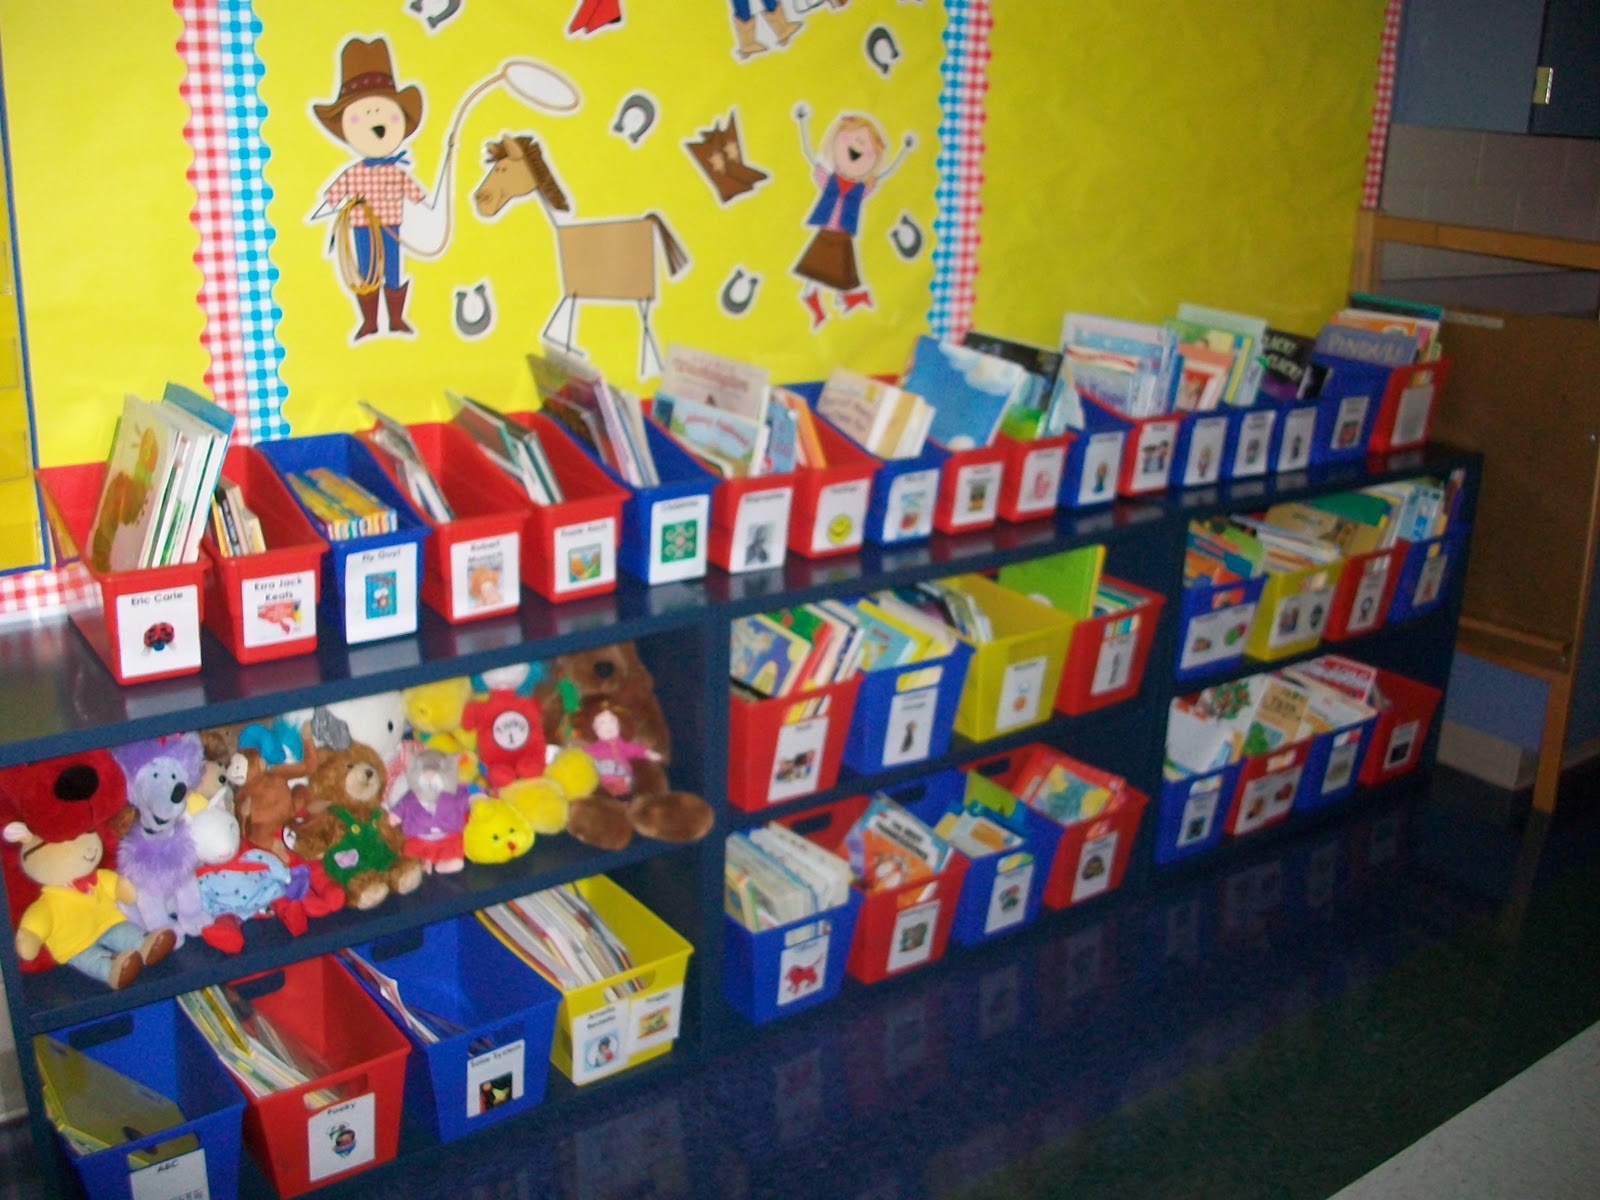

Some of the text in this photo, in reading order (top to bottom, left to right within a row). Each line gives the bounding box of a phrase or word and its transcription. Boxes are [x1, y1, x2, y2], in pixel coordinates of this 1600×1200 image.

[254, 576, 303, 591] Ezra Jack
[131, 591, 184, 606] Eric Carle
[265, 590, 294, 601] Keats
[157, 1160, 180, 1174] ABC
